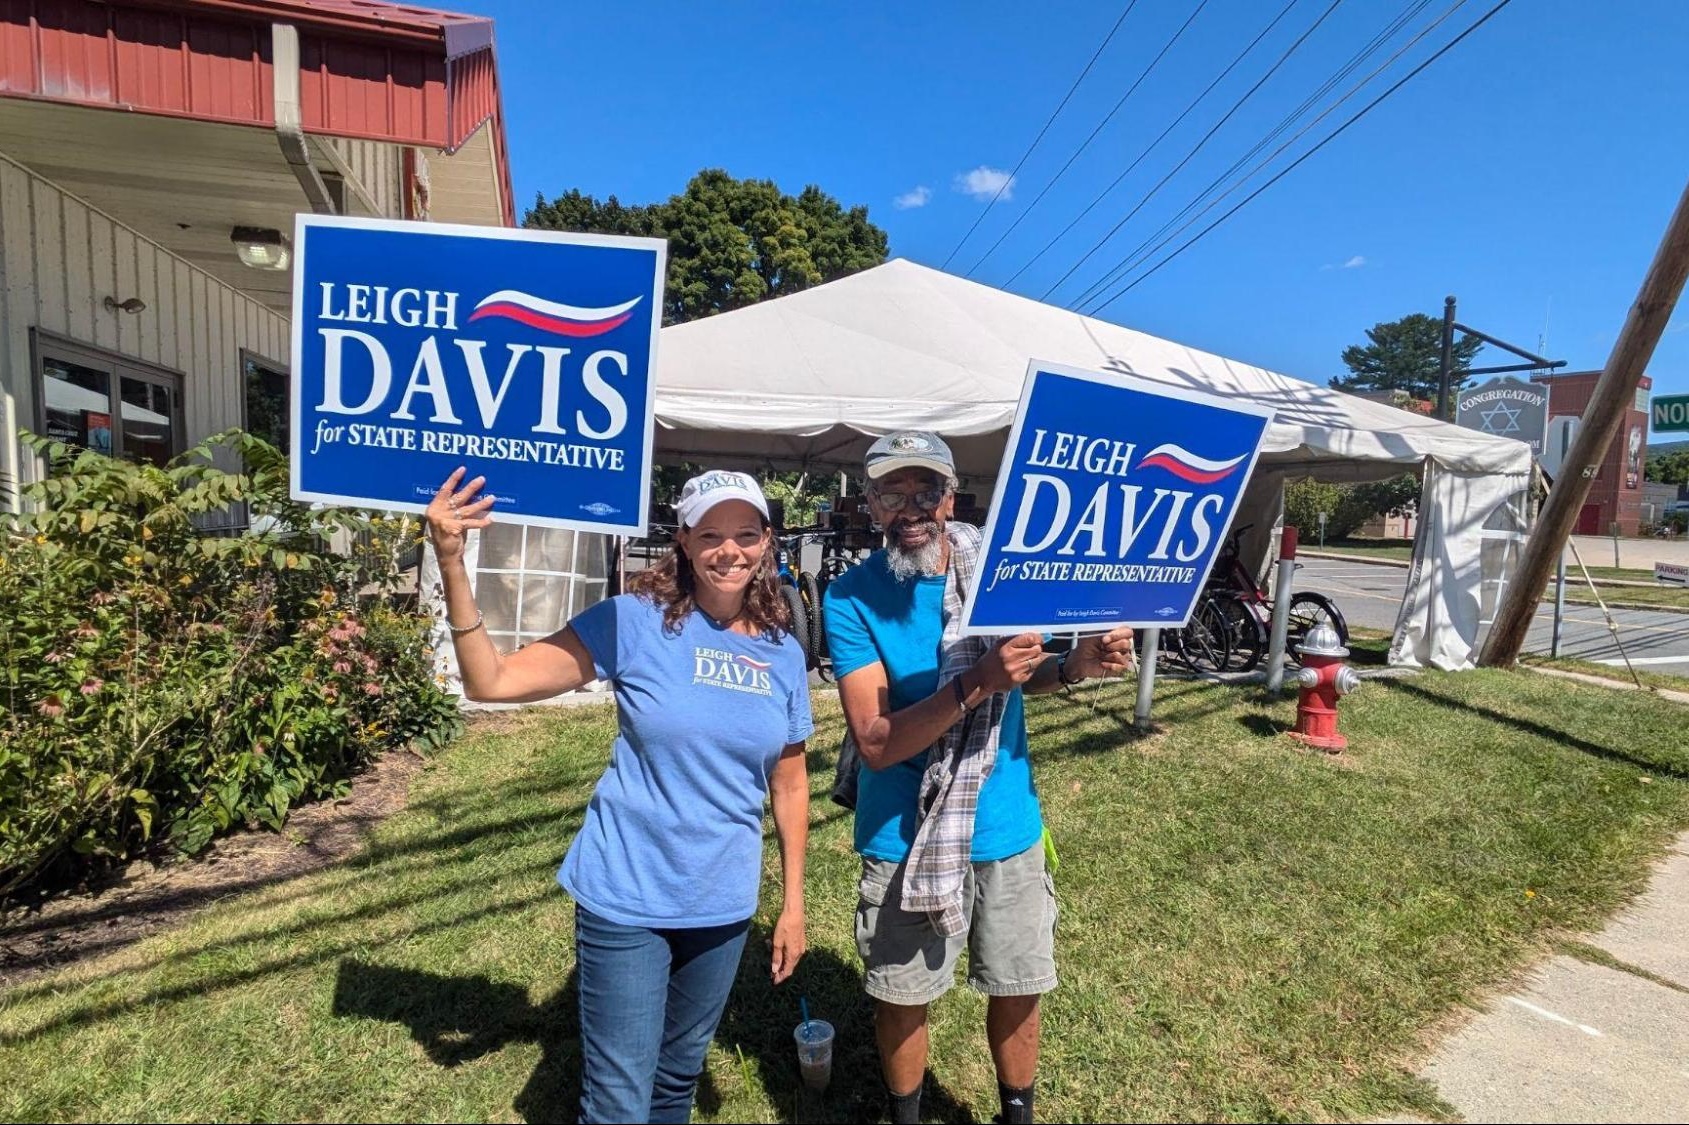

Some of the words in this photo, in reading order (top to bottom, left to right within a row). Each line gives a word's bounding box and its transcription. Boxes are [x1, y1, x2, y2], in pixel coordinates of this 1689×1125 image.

[319, 282, 459, 330] LEIGH
[315, 328, 628, 440] DAVIS
[1460, 389, 1545, 411] CONGREGATION
[311, 419, 345, 454] for
[348, 423, 416, 450] STATE
[421, 430, 624, 471] REPRESENTATIVE
[1026, 429, 1136, 476] LEIGH
[700, 474, 748, 491] DAVIS
[1001, 473, 1224, 562] DAVIS
[986, 558, 1019, 591] for
[1019, 560, 1071, 581] STATE
[1072, 562, 1196, 584] REPRESENTATIVE
[1655, 564, 1689, 576] PARKING
[695, 646, 733, 662] LEIGH
[694, 656, 771, 690] DAVIS
